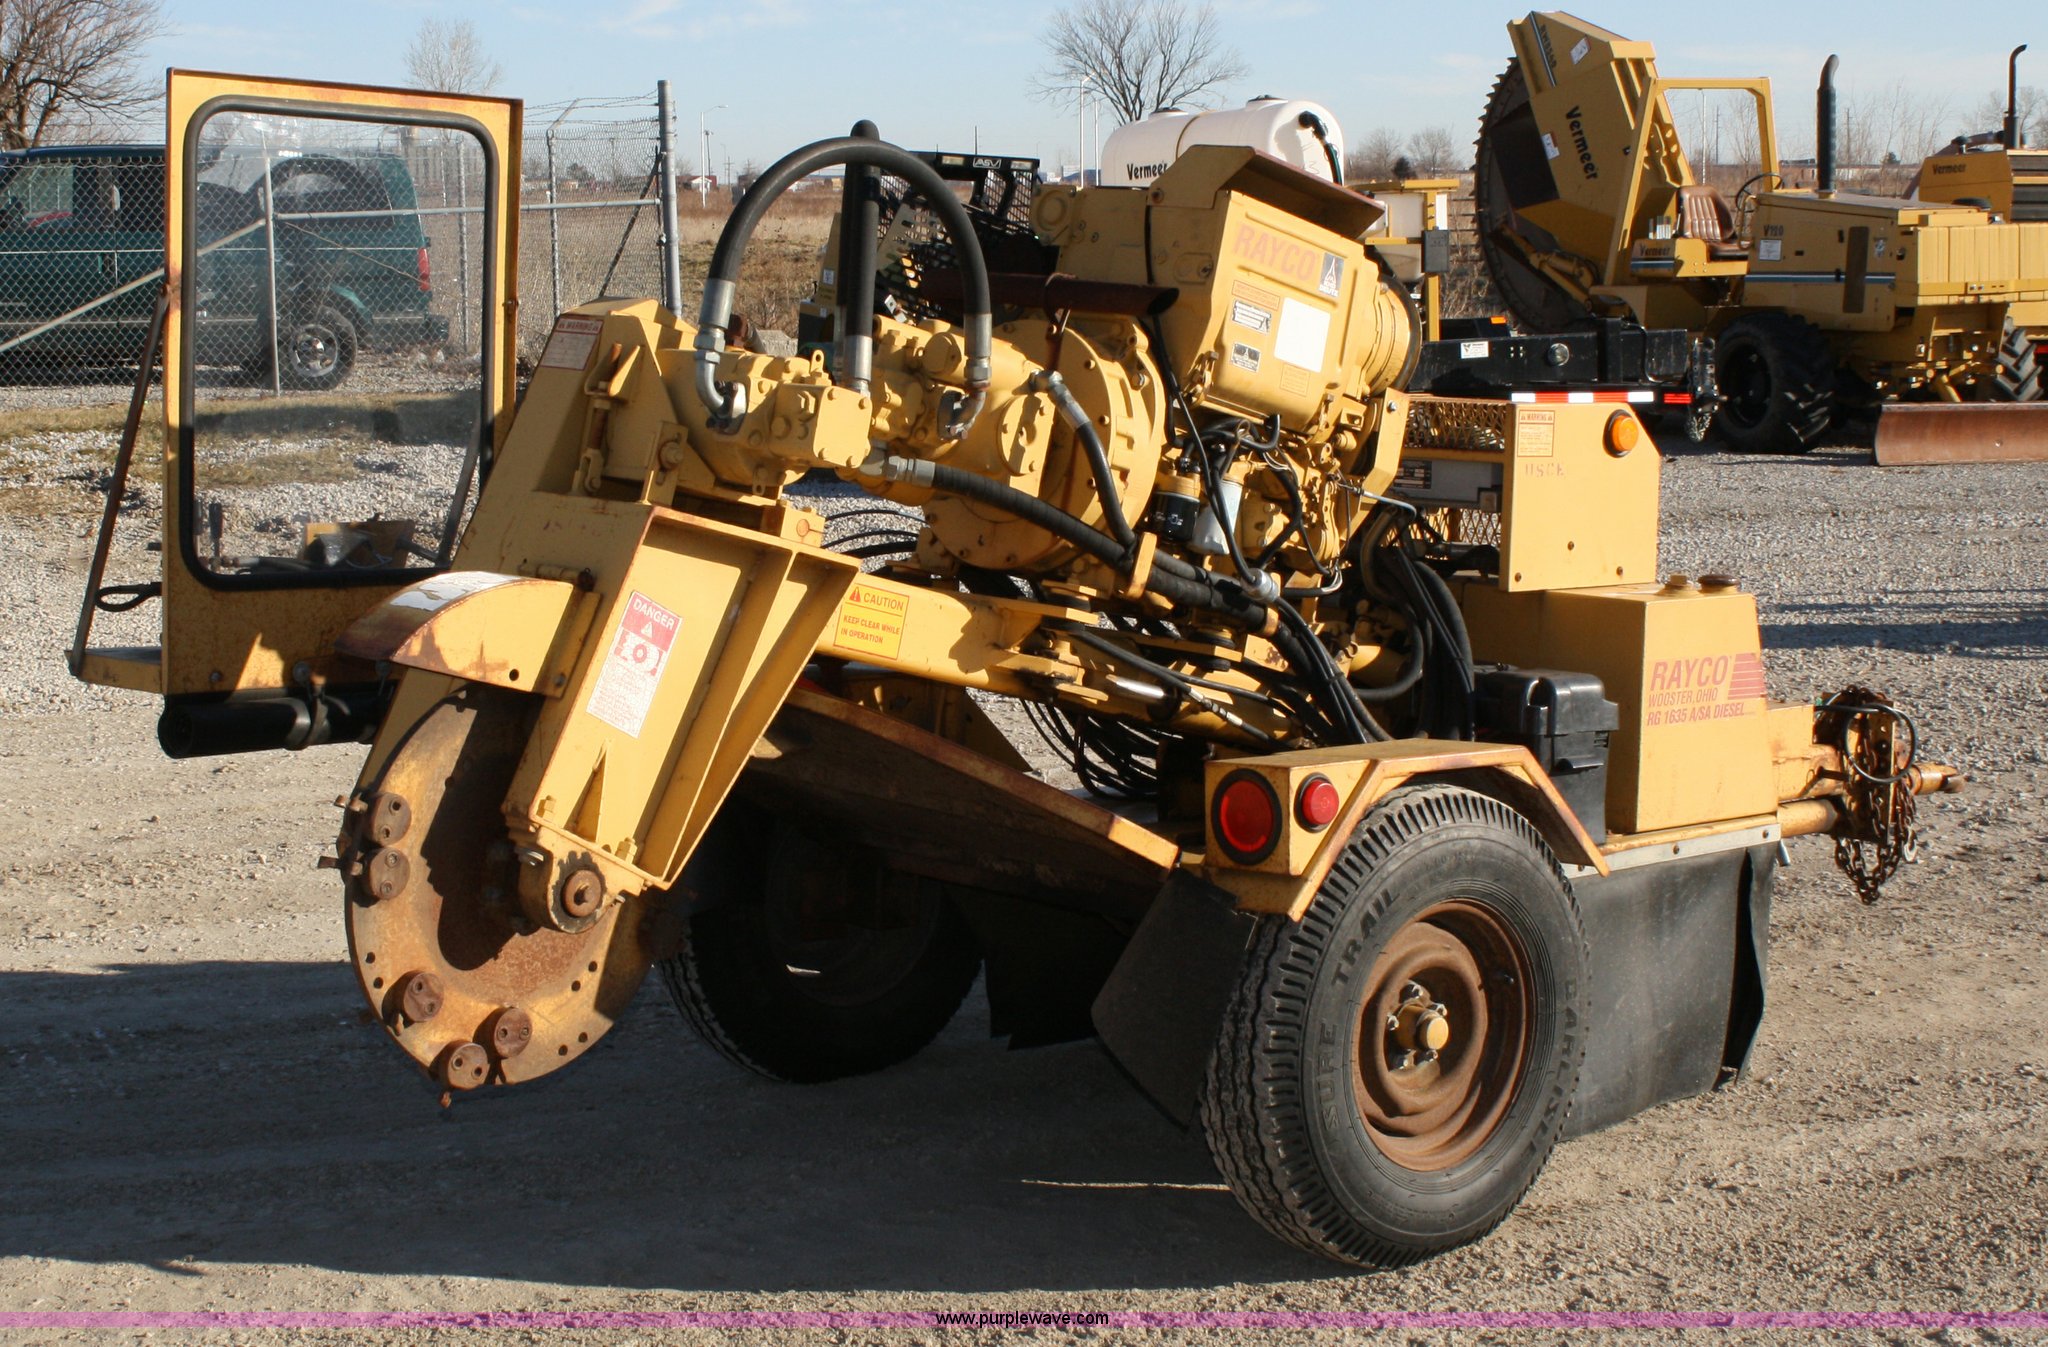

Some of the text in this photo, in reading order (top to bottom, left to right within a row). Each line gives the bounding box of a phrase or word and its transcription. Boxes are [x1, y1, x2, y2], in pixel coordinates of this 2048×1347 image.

[1565, 104, 1598, 180] Vermeer
[1126, 162, 1168, 181] Vermeer
[1932, 163, 1967, 175] Vermeer
[1232, 222, 1317, 281] RAYCO
[1639, 243, 1671, 257] Vermeer
[863, 593, 904, 611] CAUTION
[633, 598, 675, 631] DANGER
[843, 615, 900, 635] KEEP CLEAR WHILE
[841, 628, 884, 644] IN OPERATION
[1649, 655, 1729, 692] RAYCO
[1647, 702, 1745, 726] RG 1635 A/SA DIESEL
[1330, 888, 1401, 987] TRAIL
